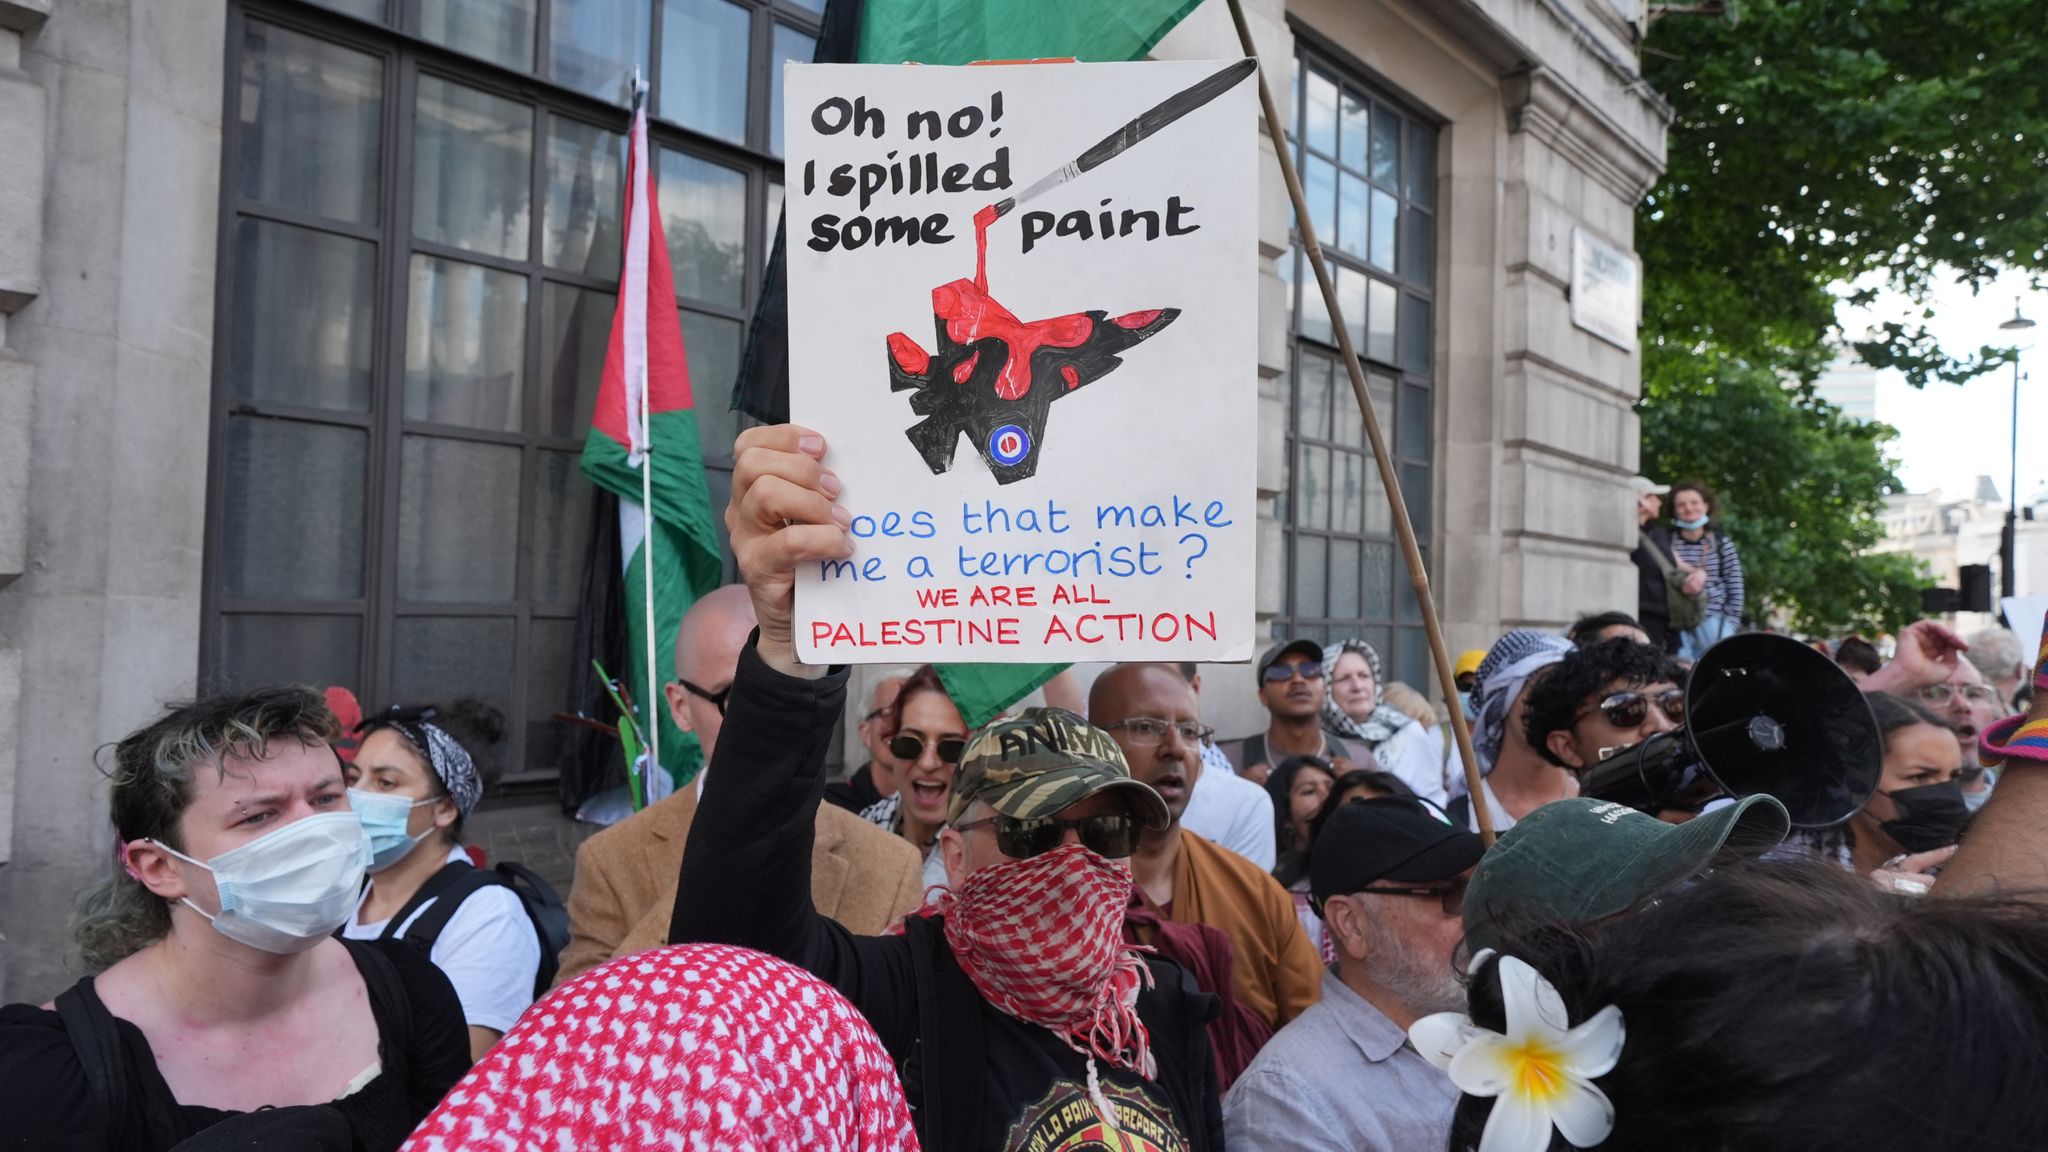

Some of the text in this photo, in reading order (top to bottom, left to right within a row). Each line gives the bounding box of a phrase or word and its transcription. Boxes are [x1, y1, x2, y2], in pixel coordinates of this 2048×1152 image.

[811, 90, 1004, 141] Oh no!
[803, 146, 1013, 212] I spilled
[806, 196, 1201, 254] some paint
[850, 495, 1233, 539] oes that make
[819, 556, 887, 582] me
[905, 555, 934, 579] a
[916, 583, 1111, 609] WE ARE ALL
[811, 611, 1217, 649] PALESTINE ACTION
[1042, 1113, 1064, 1143] LA
[1061, 1097, 1094, 1129] PAIX
